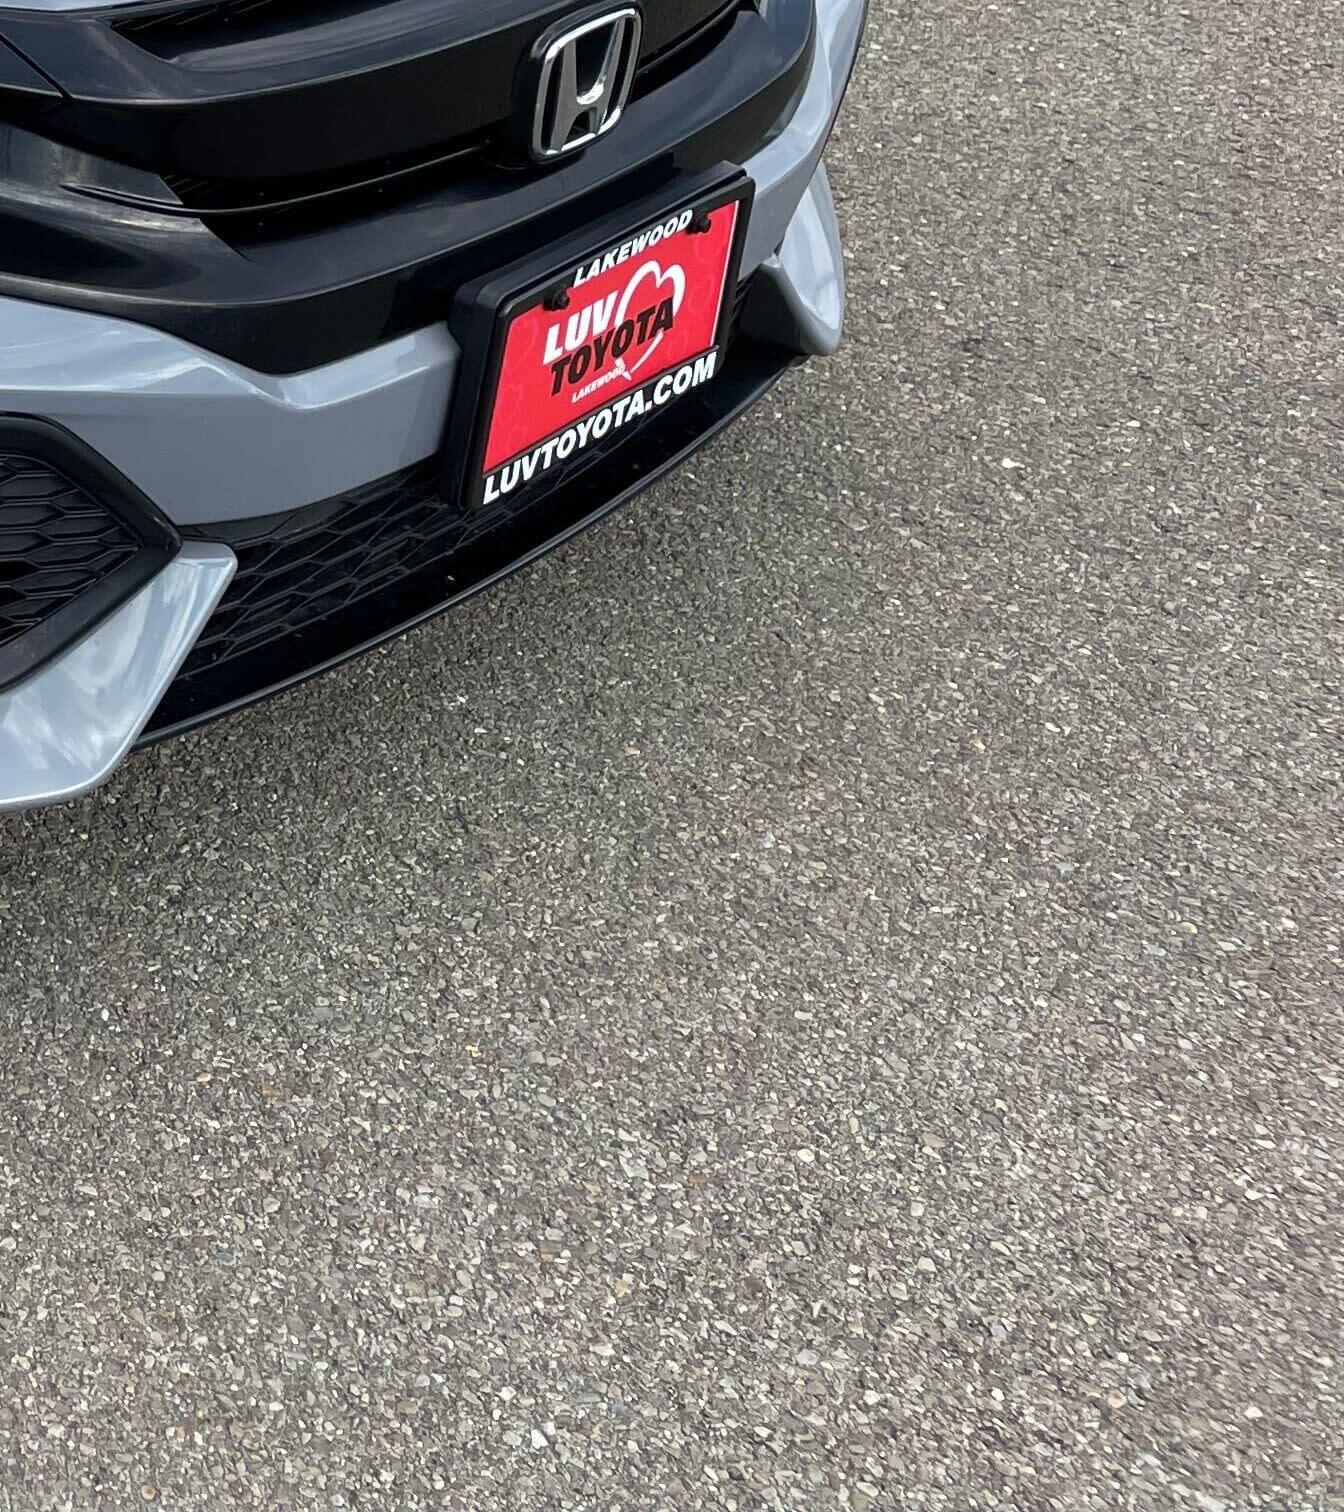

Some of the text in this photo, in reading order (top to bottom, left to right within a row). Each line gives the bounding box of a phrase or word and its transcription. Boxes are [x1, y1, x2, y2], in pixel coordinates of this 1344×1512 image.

[572, 209, 693, 289] LAKEWOOD
[543, 290, 620, 366] LUV
[551, 296, 675, 397] TOYOTA
[482, 352, 718, 506] LUVTOYOTA.COM
